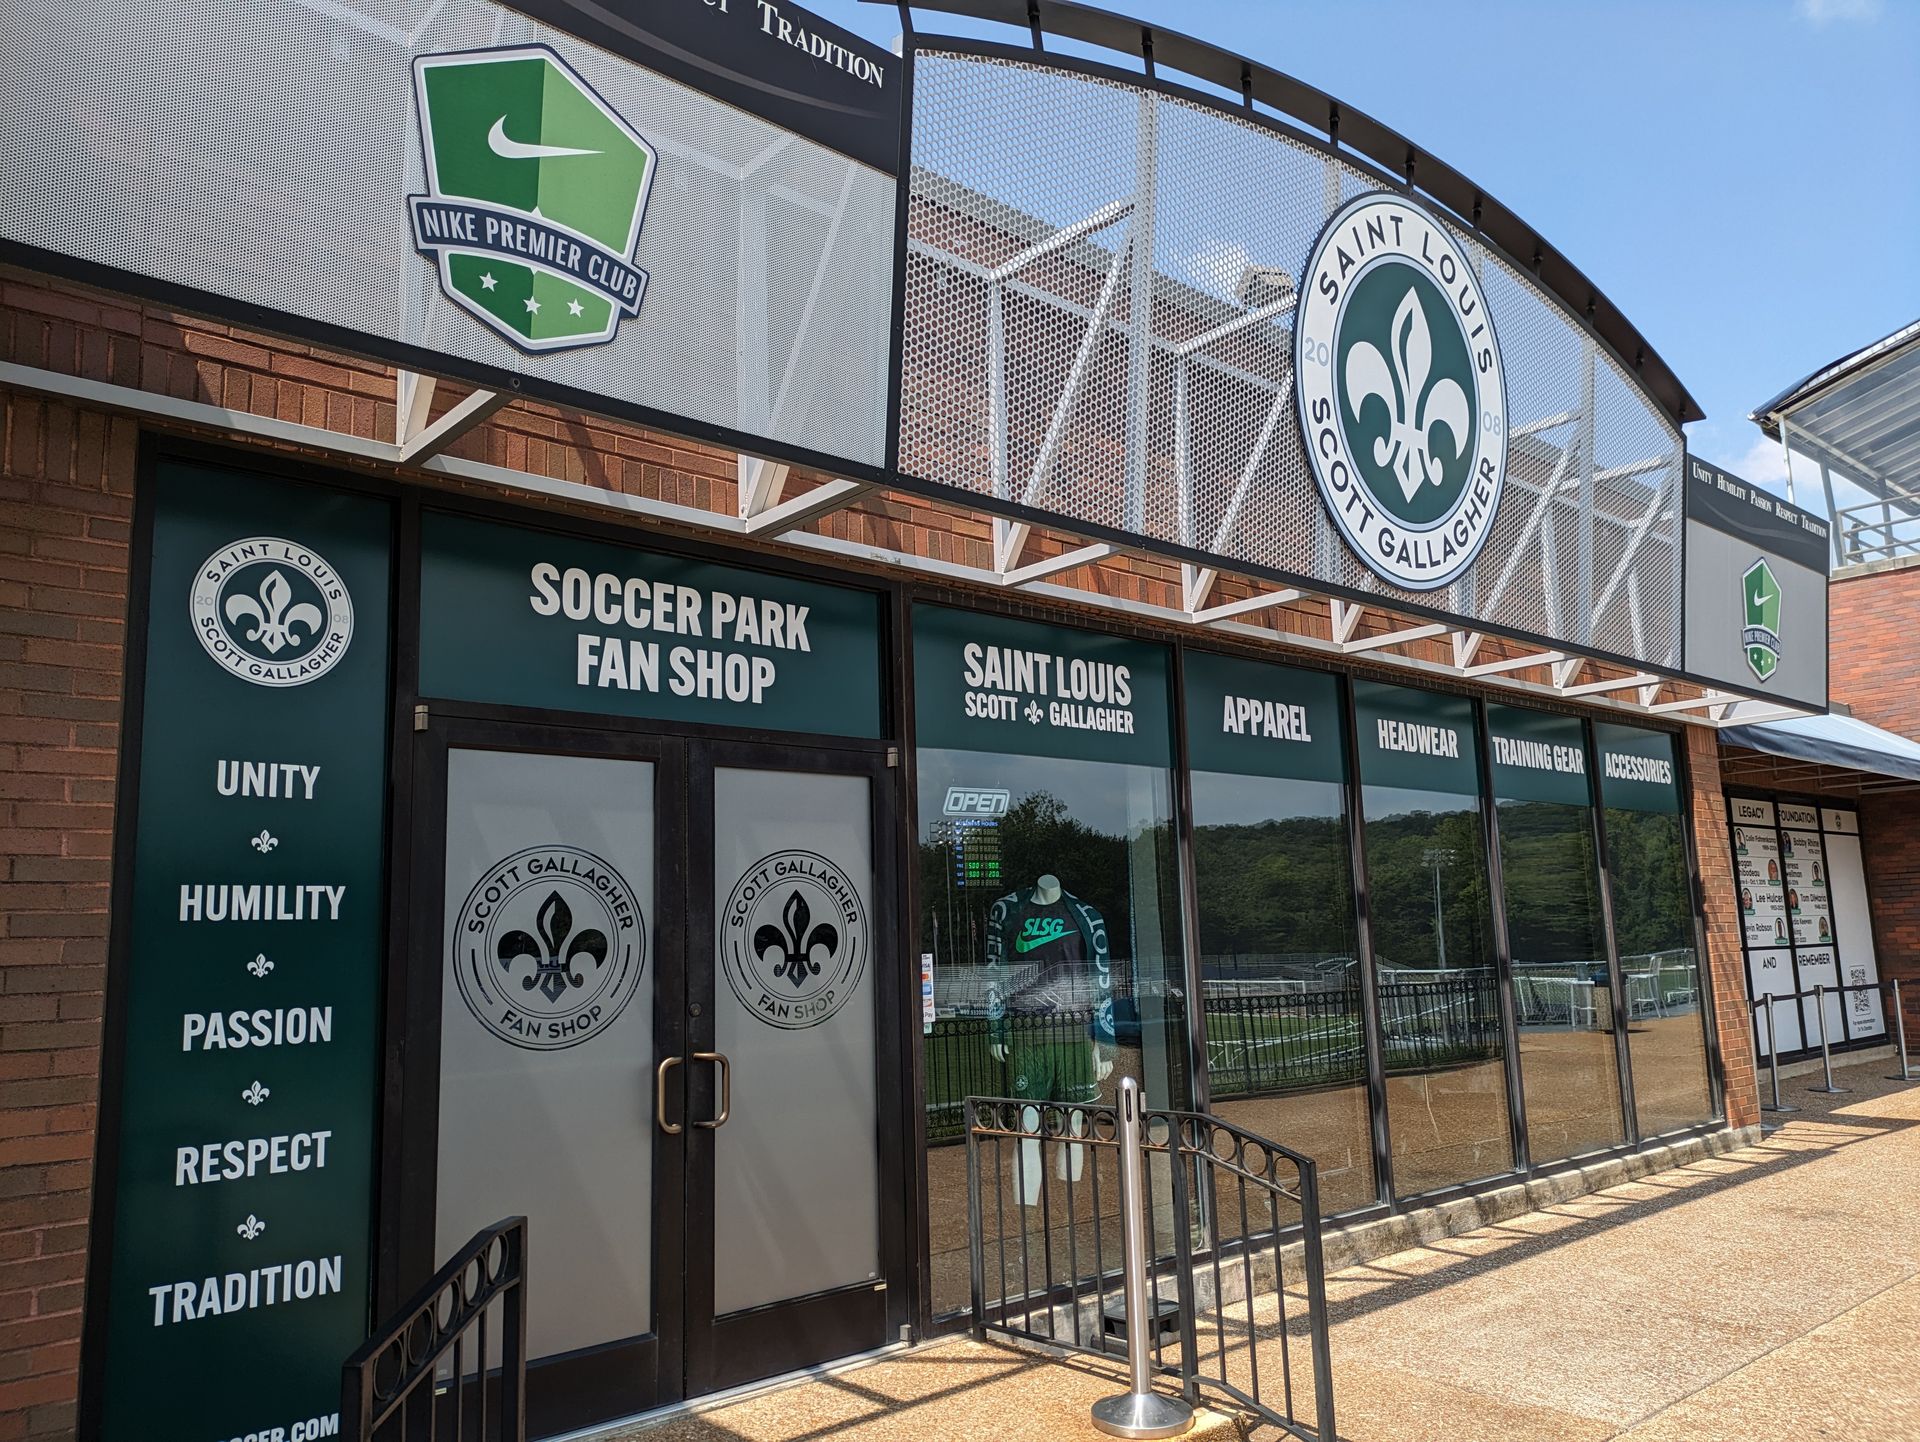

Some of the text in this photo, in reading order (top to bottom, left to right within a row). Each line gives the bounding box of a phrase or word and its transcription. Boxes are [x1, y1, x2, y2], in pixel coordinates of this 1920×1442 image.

[757, 0, 885, 89] TRADITION
[422, 208, 638, 299] NIKE PREMIER CLUB
[1319, 215, 1493, 374] SAINT LOUIS
[1304, 336, 1330, 368] 20
[1482, 410, 1501, 436] 08
[1312, 398, 1496, 569] SCOTT GALLAGHER
[206, 543, 342, 600] SAINT LOUIS
[529, 562, 811, 652] SOCCER PARK
[201, 617, 344, 680] SCOTT GALLAGHER
[577, 633, 776, 704] FAN SHOP
[963, 642, 1132, 706] SAINT LOUIS
[964, 691, 1135, 734] SCOTT GALLAGHER
[1223, 695, 1312, 742] APPAREL
[1377, 718, 1459, 759] HEADWEAR
[1492, 736, 1585, 775] TRAINING GEAR
[216, 760, 321, 800] UNITY
[1605, 752, 1671, 785] ACCESSORIES
[947, 792, 1006, 813] OPEN
[1738, 805, 1765, 819] LEGACY
[1778, 809, 1816, 824] FOUNDATION
[179, 884, 346, 922] HUMILITY
[468, 856, 633, 934] SCOTT GALLAGHER
[731, 859, 858, 928] SCOTT GALLAGHER
[1022, 917, 1065, 936] SLSG
[1762, 956, 1777, 969] AND
[1798, 953, 1831, 967] REMEMBER
[500, 1005, 602, 1039] FAN SHOP
[757, 990, 836, 1019] FAN SHOP
[182, 1006, 333, 1052] PASSION
[175, 1130, 332, 1187] RESPECT
[148, 1255, 342, 1327] TRADITION
